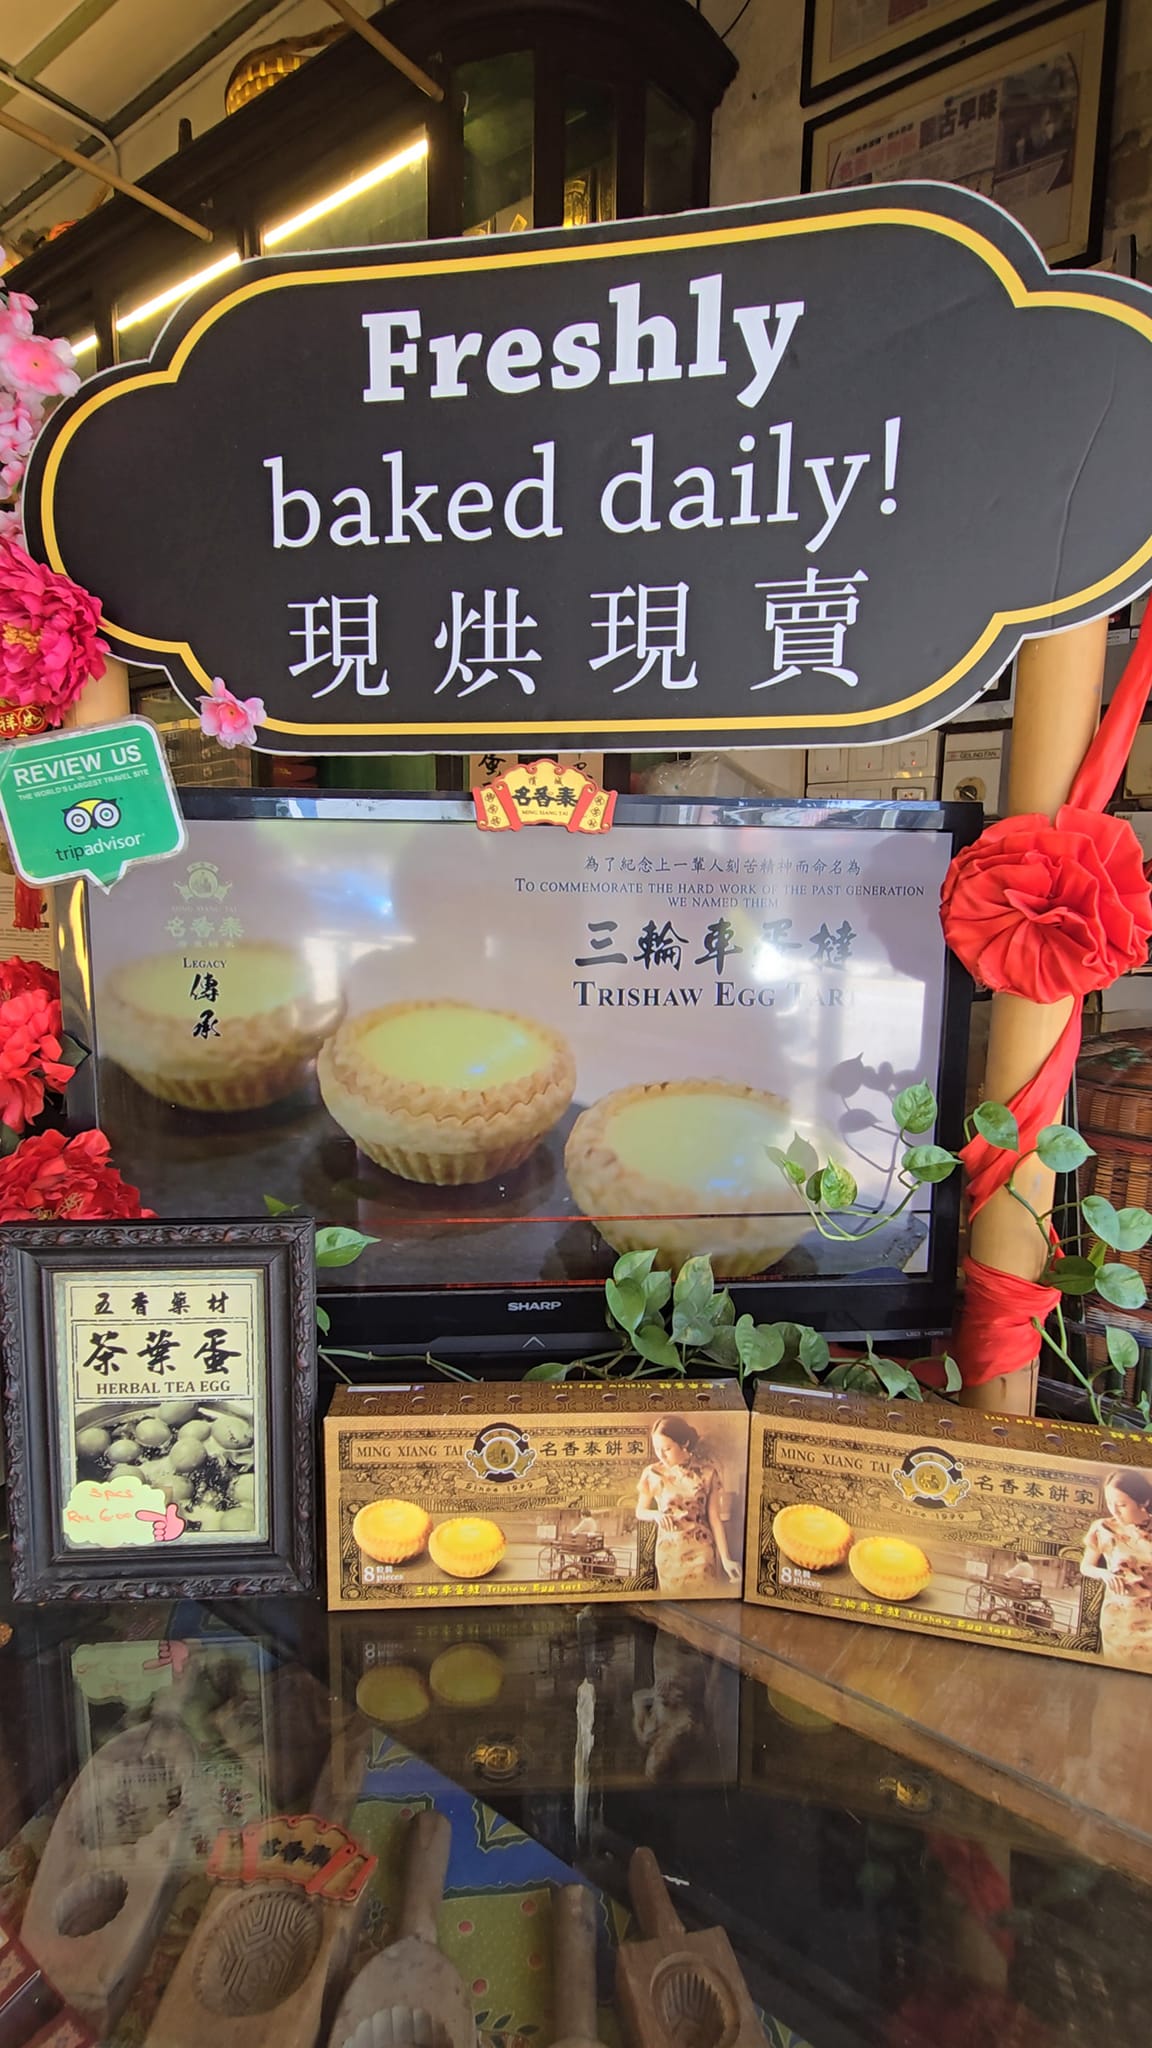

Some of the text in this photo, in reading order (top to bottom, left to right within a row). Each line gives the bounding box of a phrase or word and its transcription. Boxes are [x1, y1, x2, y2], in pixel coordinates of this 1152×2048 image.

[362, 273, 804, 408] Freshly
[263, 416, 901, 553] baked daily!
[287, 567, 869, 699] 現烘現賣
[13, 744, 142, 787] REVIEW US
[18, 768, 149, 801] THE WORLD'S LARGEST TRAVEL SITE
[511, 785, 579, 808] 名香泰
[55, 832, 143, 862] tripadvisor
[540, 881, 644, 894] COMMEMORATE
[648, 882, 674, 894] THE
[678, 882, 714, 895] HARD
[719, 883, 757, 895] WORK
[811, 884, 841, 896] PAST
[846, 885, 925, 897] GENERATION
[668, 896, 778, 909] WE NAMED THEM
[183, 957, 228, 969] LEGACY
[572, 981, 856, 1008] TRISHAW EGG TAR
[507, 1301, 562, 1312] SHARP
[82, 1327, 242, 1377] 茶葉蛋
[96, 1379, 231, 1395] HERBAL TEA EGG
[356, 1445, 464, 1458] MING XIANG TAI
[539, 1439, 645, 1457] 名香泰餅家
[780, 1446, 891, 1474] MING XIANG TAI
[973, 1474, 1095, 1506] 名香泰餅家
[363, 1565, 375, 1583] 8
[780, 1566, 792, 1584] 8
